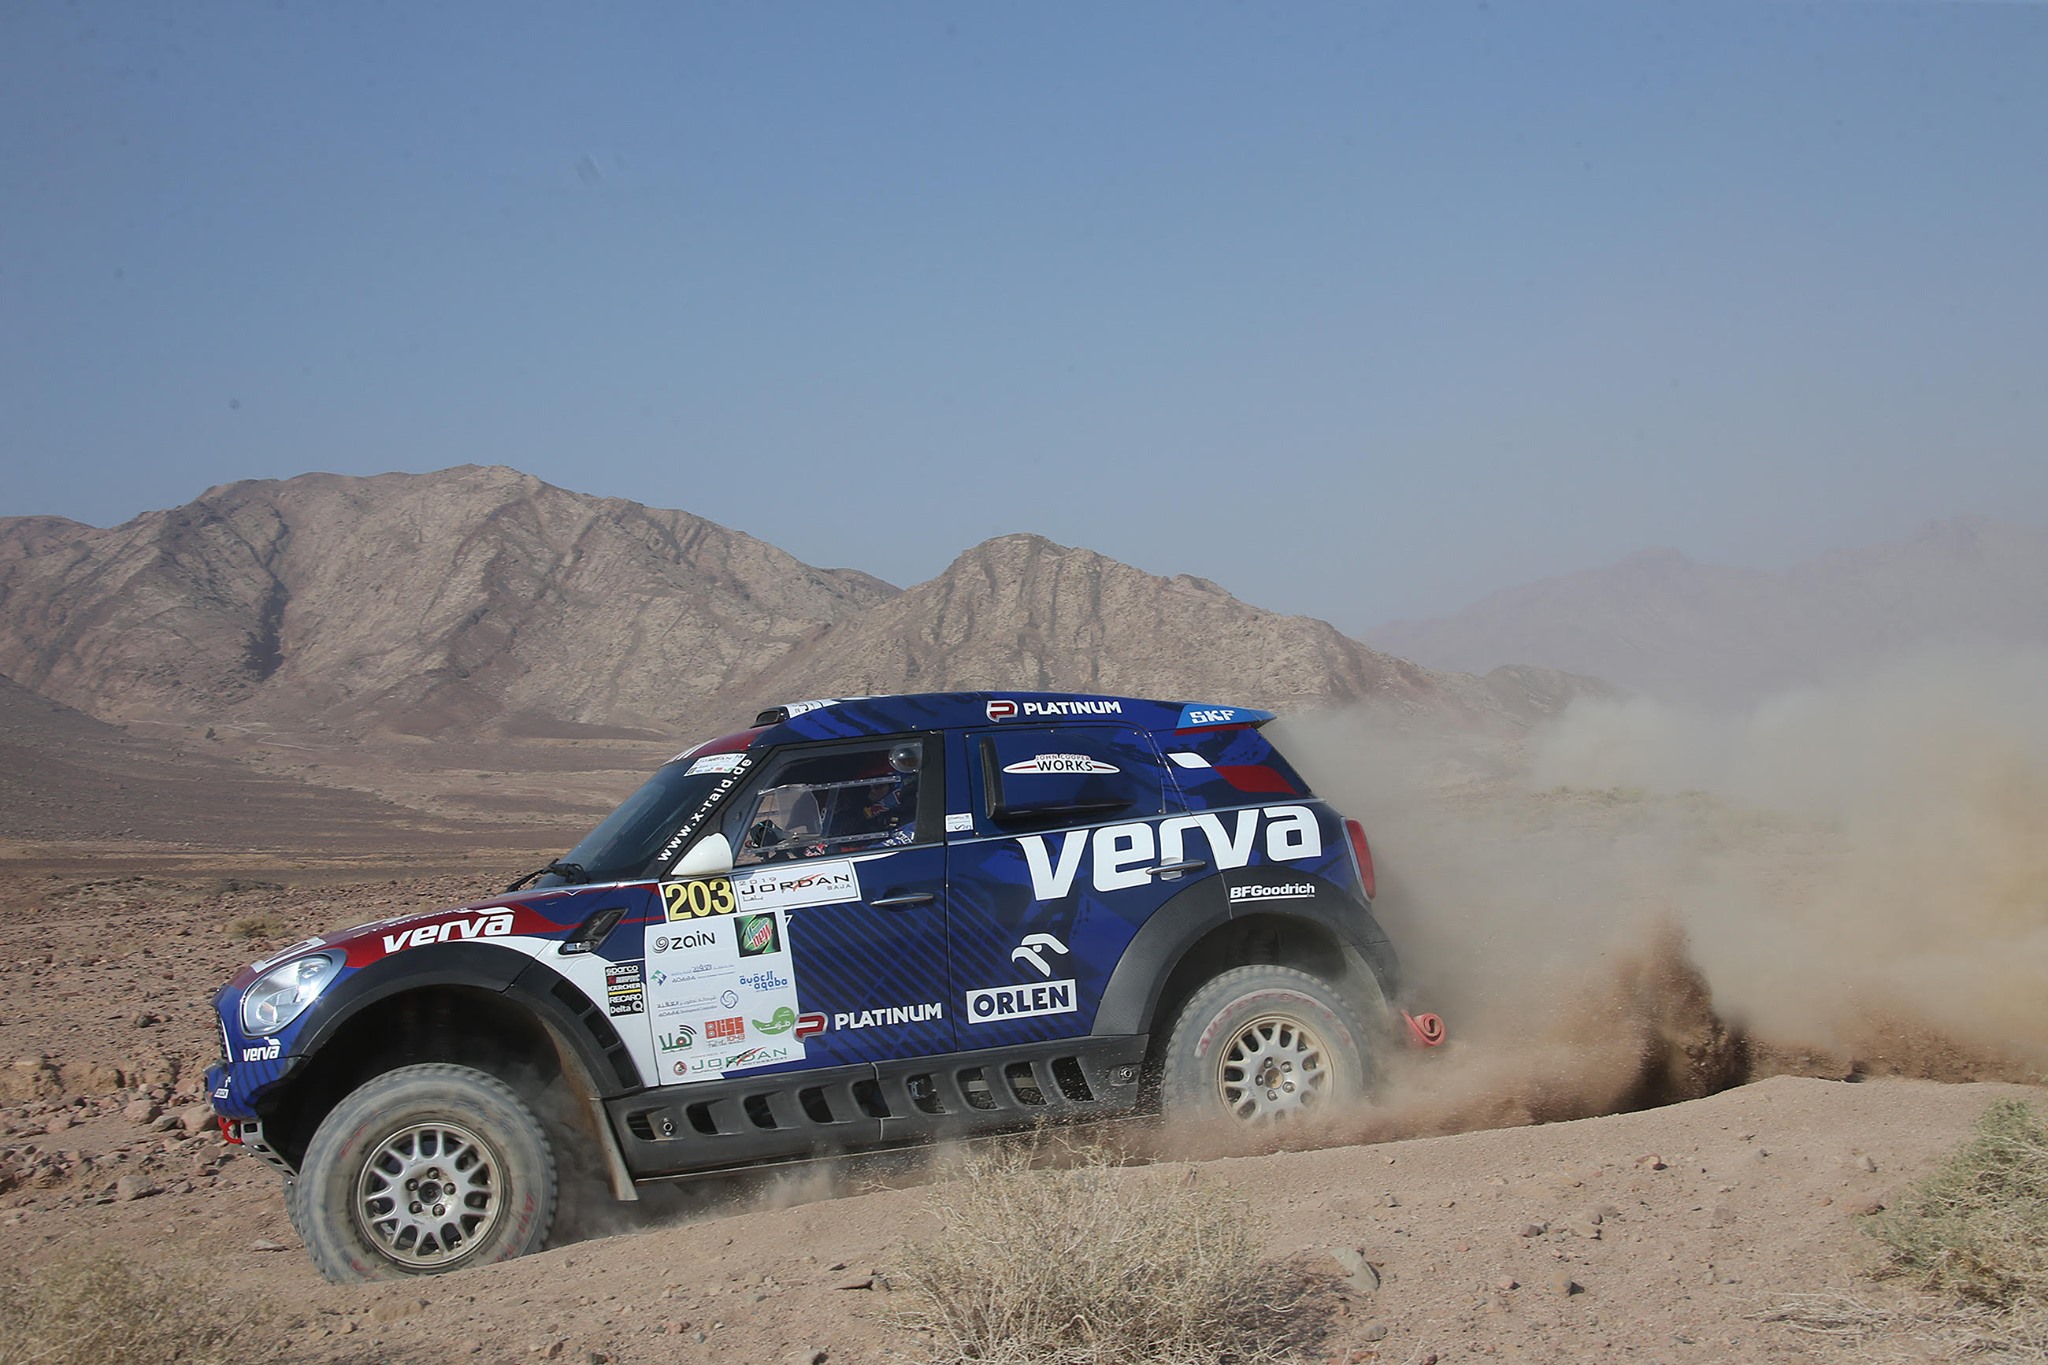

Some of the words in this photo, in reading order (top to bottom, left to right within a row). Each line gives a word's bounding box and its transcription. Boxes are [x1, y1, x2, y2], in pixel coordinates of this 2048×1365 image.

[1023, 701, 1122, 715] PLATINUM
[1190, 709, 1235, 724] SKF
[1036, 760, 1093, 772] WORKS
[657, 758, 753, 862] www.x-raid.de
[1015, 805, 1322, 901] verva
[741, 874, 850, 895] JORDAN
[827, 883, 852, 891] BAJA
[1230, 883, 1315, 898] BFGoodrich
[665, 878, 735, 921] 203
[382, 914, 514, 954] verva
[671, 930, 715, 951] zain
[754, 977, 788, 991] aqaba
[609, 993, 643, 1003] RECARO
[973, 984, 1070, 1017] ORLEN
[610, 1004, 631, 1014] Delta
[834, 1002, 942, 1031] PLATINUM
[243, 1045, 280, 1062] verva
[692, 1047, 788, 1071] JORDAN
